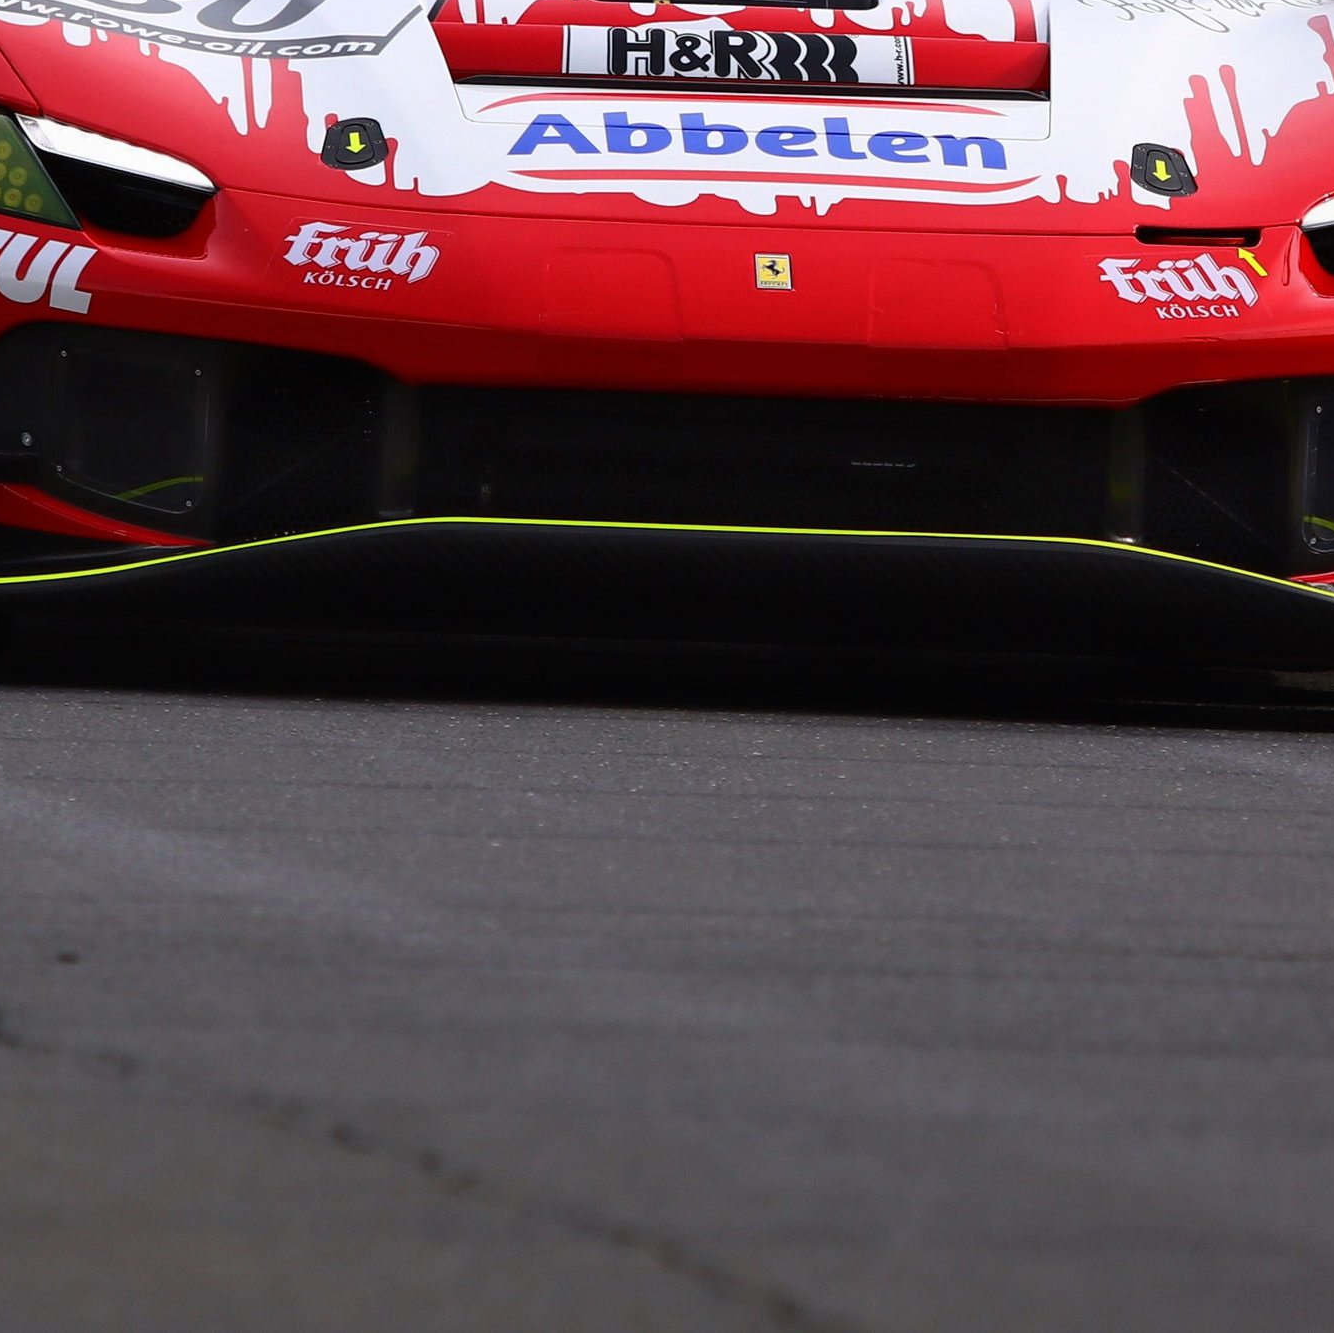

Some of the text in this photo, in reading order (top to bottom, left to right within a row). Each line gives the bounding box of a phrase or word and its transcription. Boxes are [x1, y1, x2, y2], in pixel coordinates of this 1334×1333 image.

[608, 27, 766, 79] H&R
[506, 112, 1008, 170] Abbelen
[303, 271, 392, 291] KÖLSCH
[1155, 304, 1240, 319] KÖLSCH
